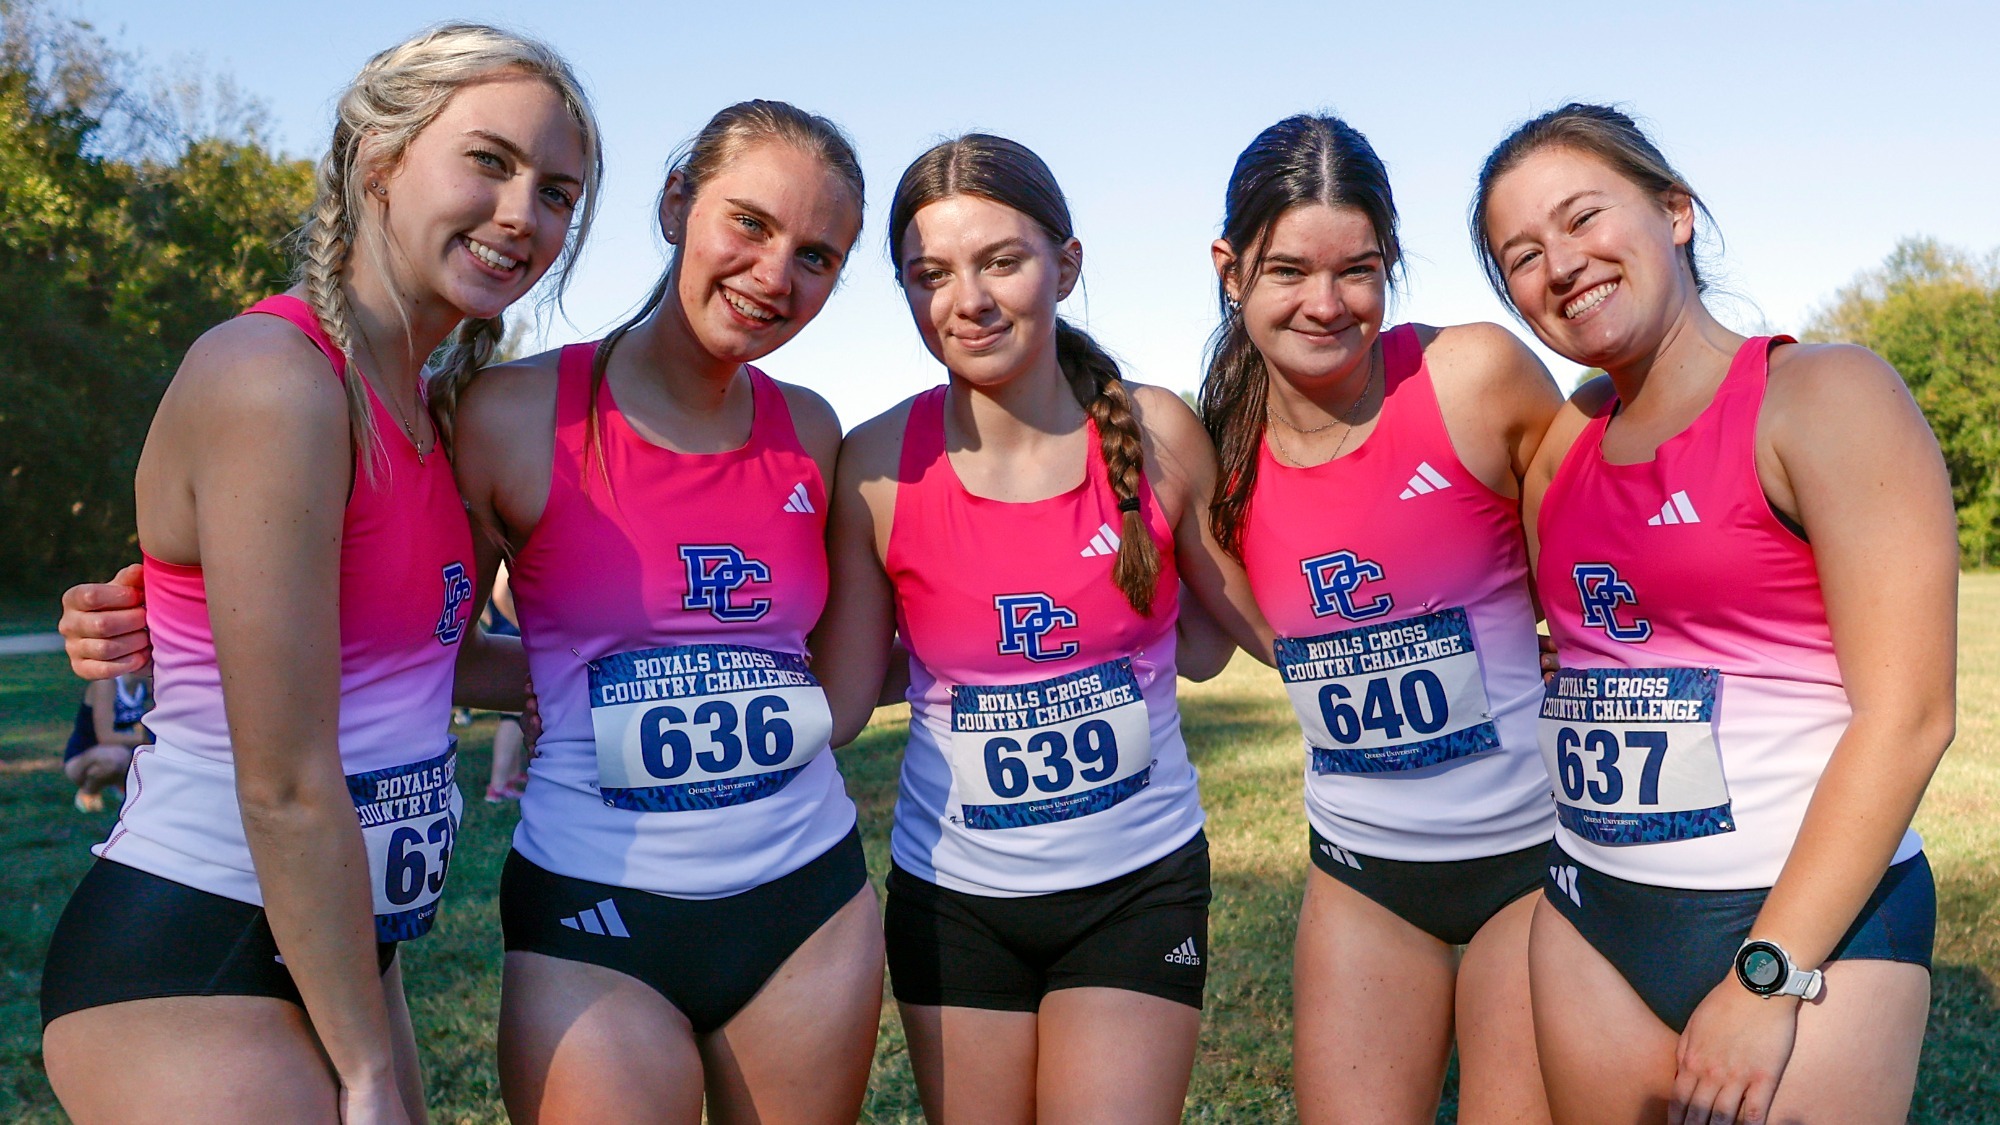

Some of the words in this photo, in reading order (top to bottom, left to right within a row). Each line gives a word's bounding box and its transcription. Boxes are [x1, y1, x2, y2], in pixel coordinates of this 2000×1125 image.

[677, 543, 772, 623] PC
[1299, 548, 1395, 622] PC
[1572, 562, 1653, 643] PC
[992, 591, 1079, 663] PC
[1306, 636, 1364, 661] ROYALS
[1368, 623, 1428, 651] CROSS
[634, 653, 711, 679] ROYALS
[717, 651, 776, 671] CROSS
[1286, 656, 1355, 682] COUNTRY
[1360, 635, 1463, 673] CHALLENGE
[601, 675, 697, 704] COUNTRY
[705, 670, 811, 694] CHALLENGE
[957, 709, 1029, 731] COUNTRY
[1035, 684, 1135, 725] CHALLENGE
[977, 690, 1040, 712] ROYALS
[1045, 674, 1103, 702] CROSS
[1318, 669, 1449, 745] 640
[1542, 697, 1587, 720] COUNTRY
[1592, 700, 1703, 721] CHALLENGE
[1558, 676, 1598, 698] ROYALS
[1604, 677, 1669, 698] CROSS
[640, 694, 794, 780] 636
[983, 719, 1119, 799] 639
[375, 766, 442, 800] ROYALS
[1557, 726, 1669, 806] 637
[385, 816, 456, 905] 63
[1164, 953, 1201, 966] adidas
